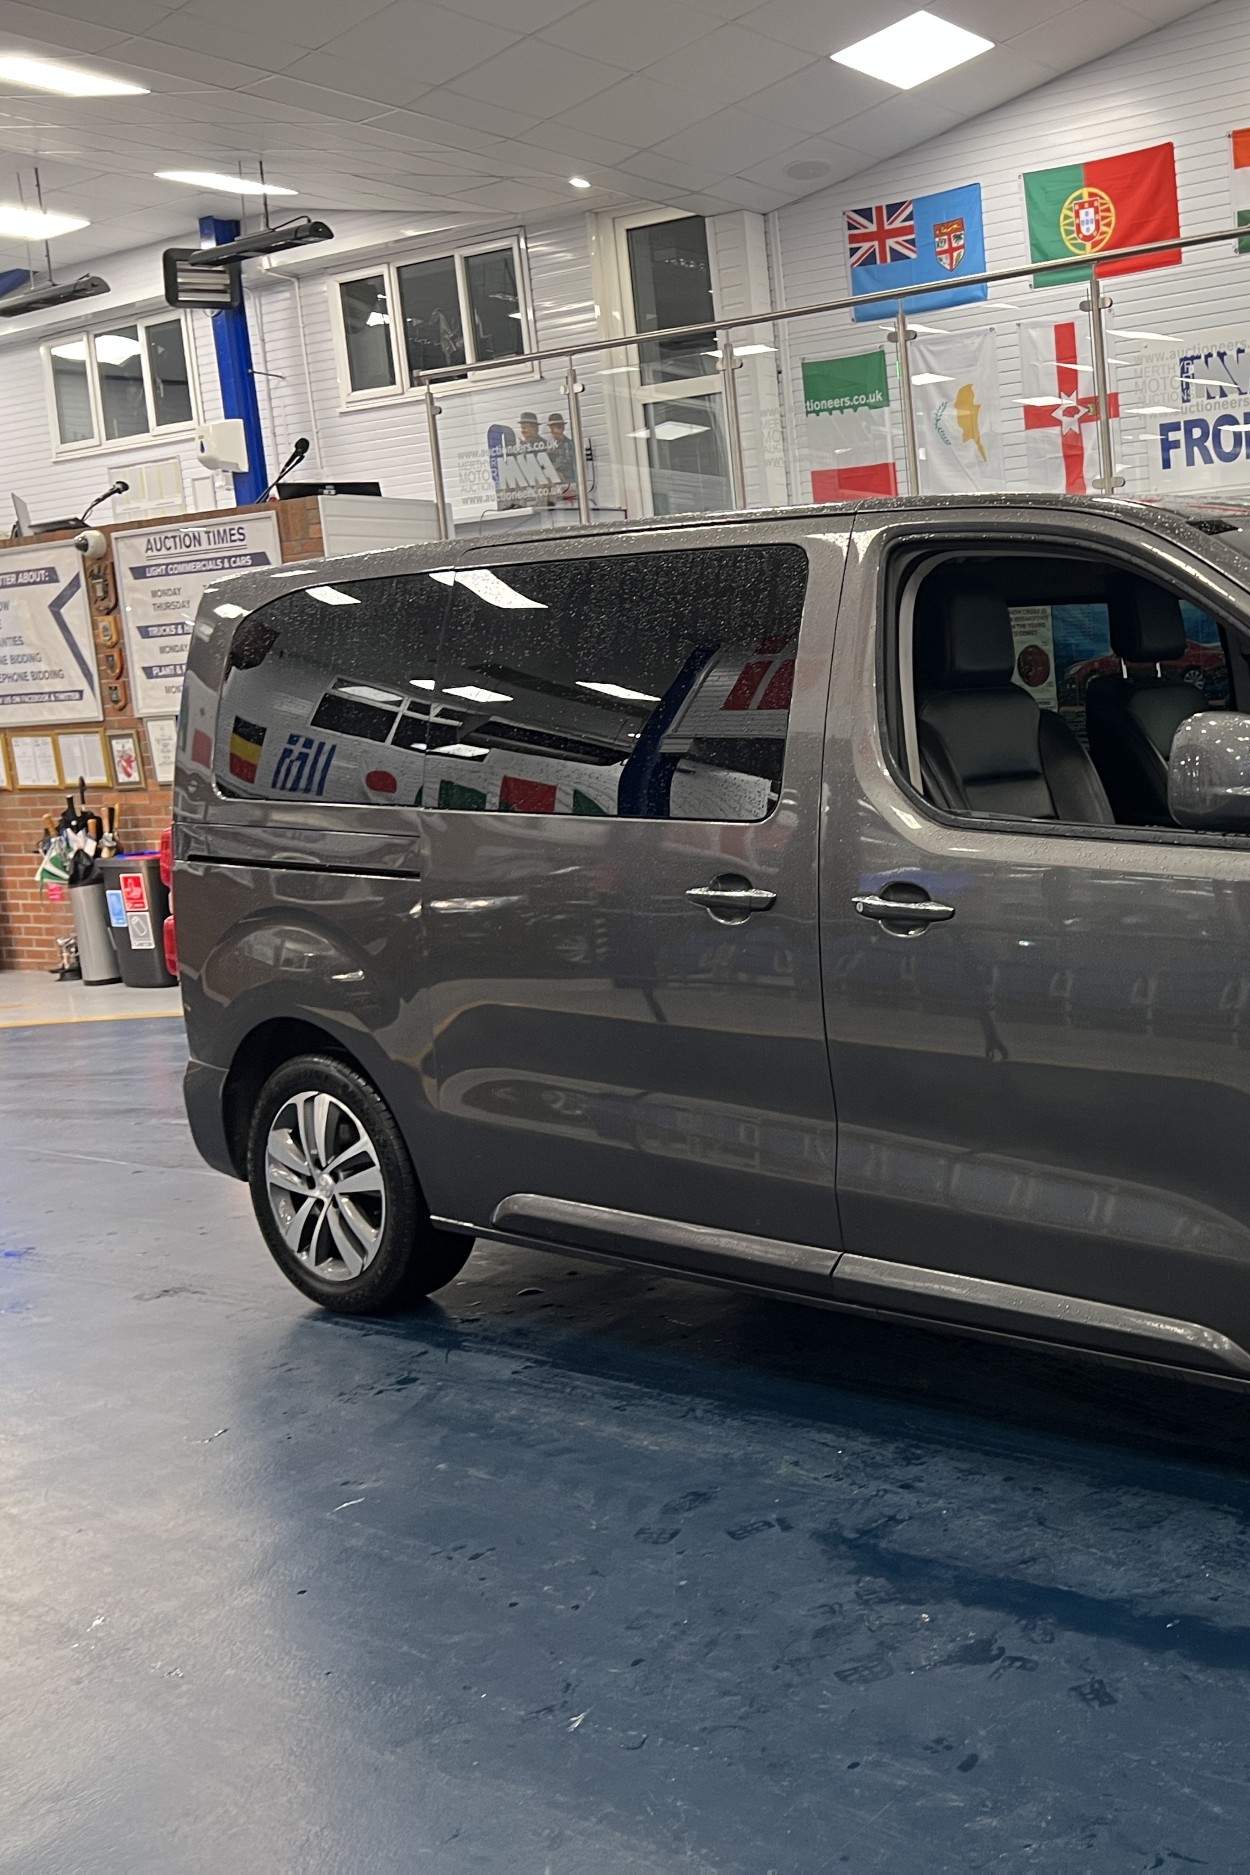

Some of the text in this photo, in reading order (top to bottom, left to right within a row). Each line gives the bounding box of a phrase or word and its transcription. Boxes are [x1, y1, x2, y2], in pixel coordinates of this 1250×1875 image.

[145, 526, 246, 553] AUCTION TIMES
[146, 556, 252, 577] LIGHT COMMERCIALS & CARS
[18, 569, 49, 583] ABOUT:
[151, 587, 182, 599] MONDAY
[152, 600, 191, 611] THURSDAY
[147, 625, 176, 636] TRUCKS
[159, 644, 188, 654] MONDAY
[10, 652, 42, 665] BIDDING
[30, 669, 65, 681] BIDDING
[152, 665, 175, 676] PLANT
